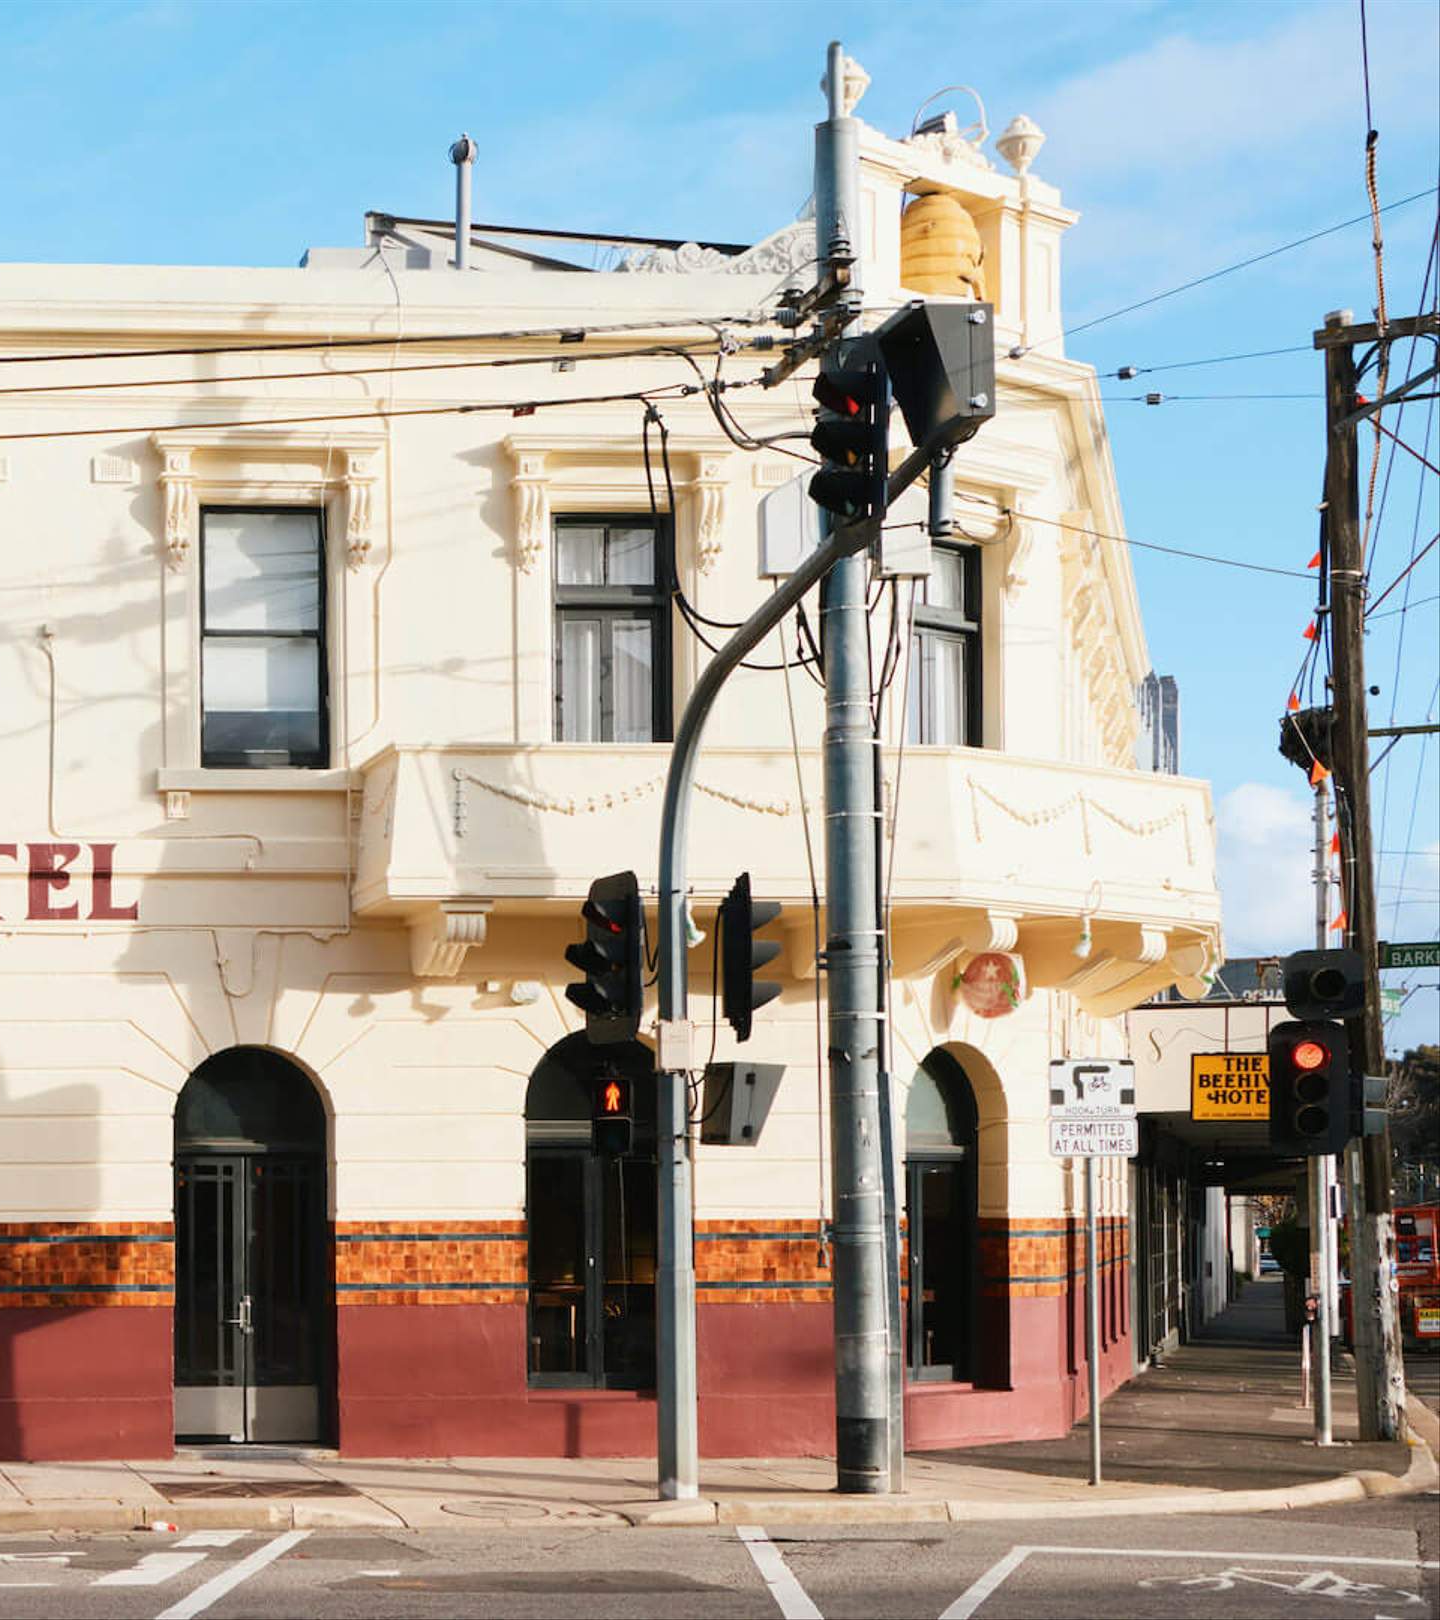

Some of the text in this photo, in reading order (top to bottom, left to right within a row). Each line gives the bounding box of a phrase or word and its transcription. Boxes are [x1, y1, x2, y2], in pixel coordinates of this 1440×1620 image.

[1224, 1057, 1262, 1072] THE
[1199, 1073, 1271, 1088] BEEHIV
[1207, 1089, 1268, 1104] HOTE
[1061, 1123, 1125, 1136] PERMITTED
[1055, 1139, 1133, 1152] AT ALL TIMES
